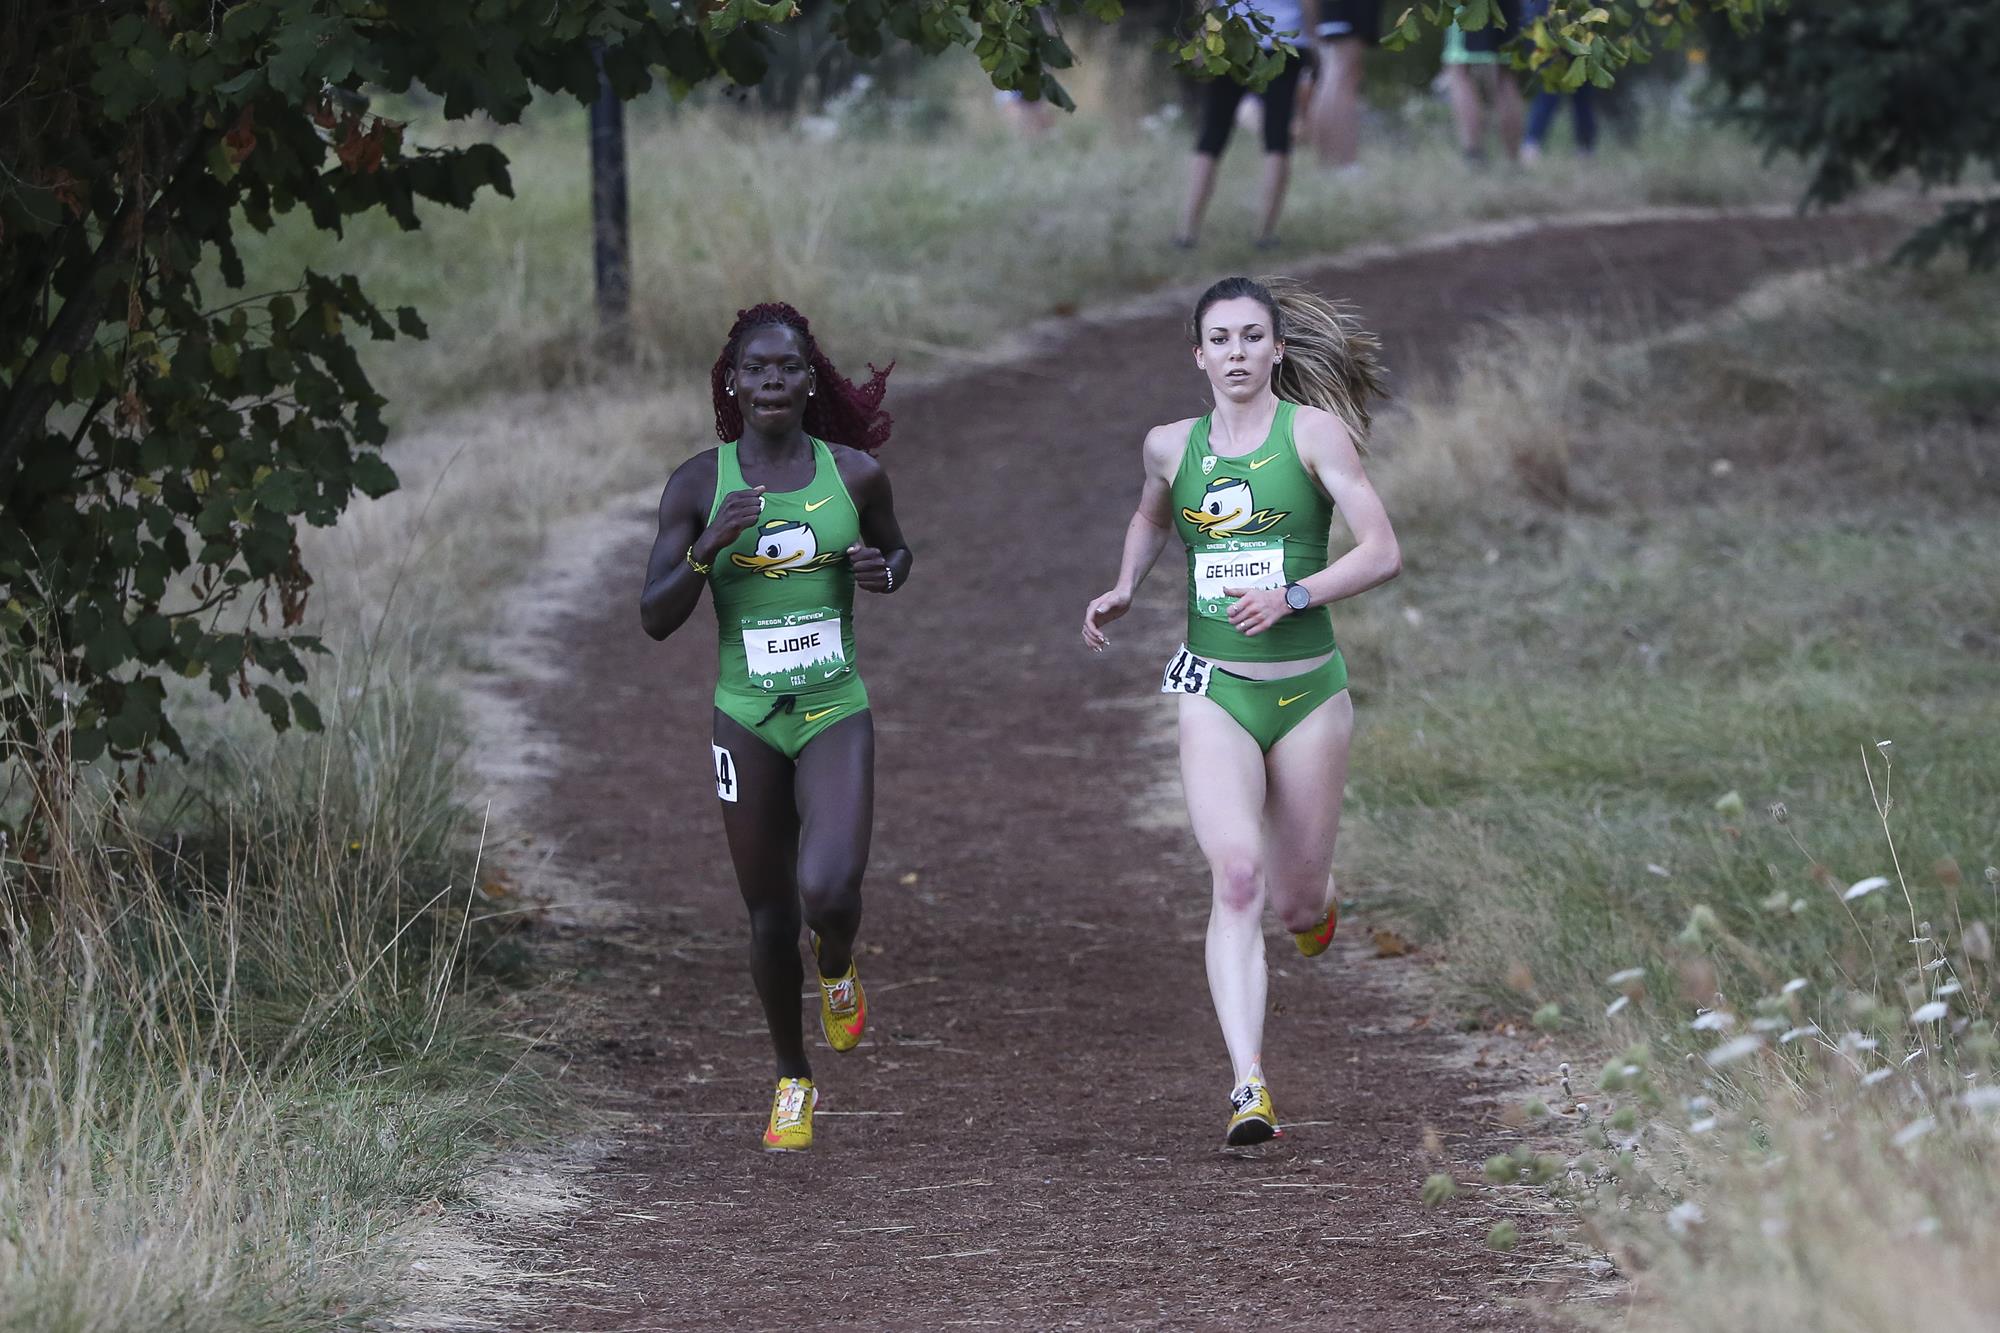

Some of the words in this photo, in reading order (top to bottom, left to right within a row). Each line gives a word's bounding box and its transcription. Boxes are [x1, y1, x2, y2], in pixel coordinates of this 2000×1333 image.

[1206, 561, 1271, 579] GEHRICH
[757, 618, 782, 626] OREGON
[797, 612, 824, 622] PREVIEW
[767, 632, 821, 654] EJORE
[1169, 651, 1207, 693] 45
